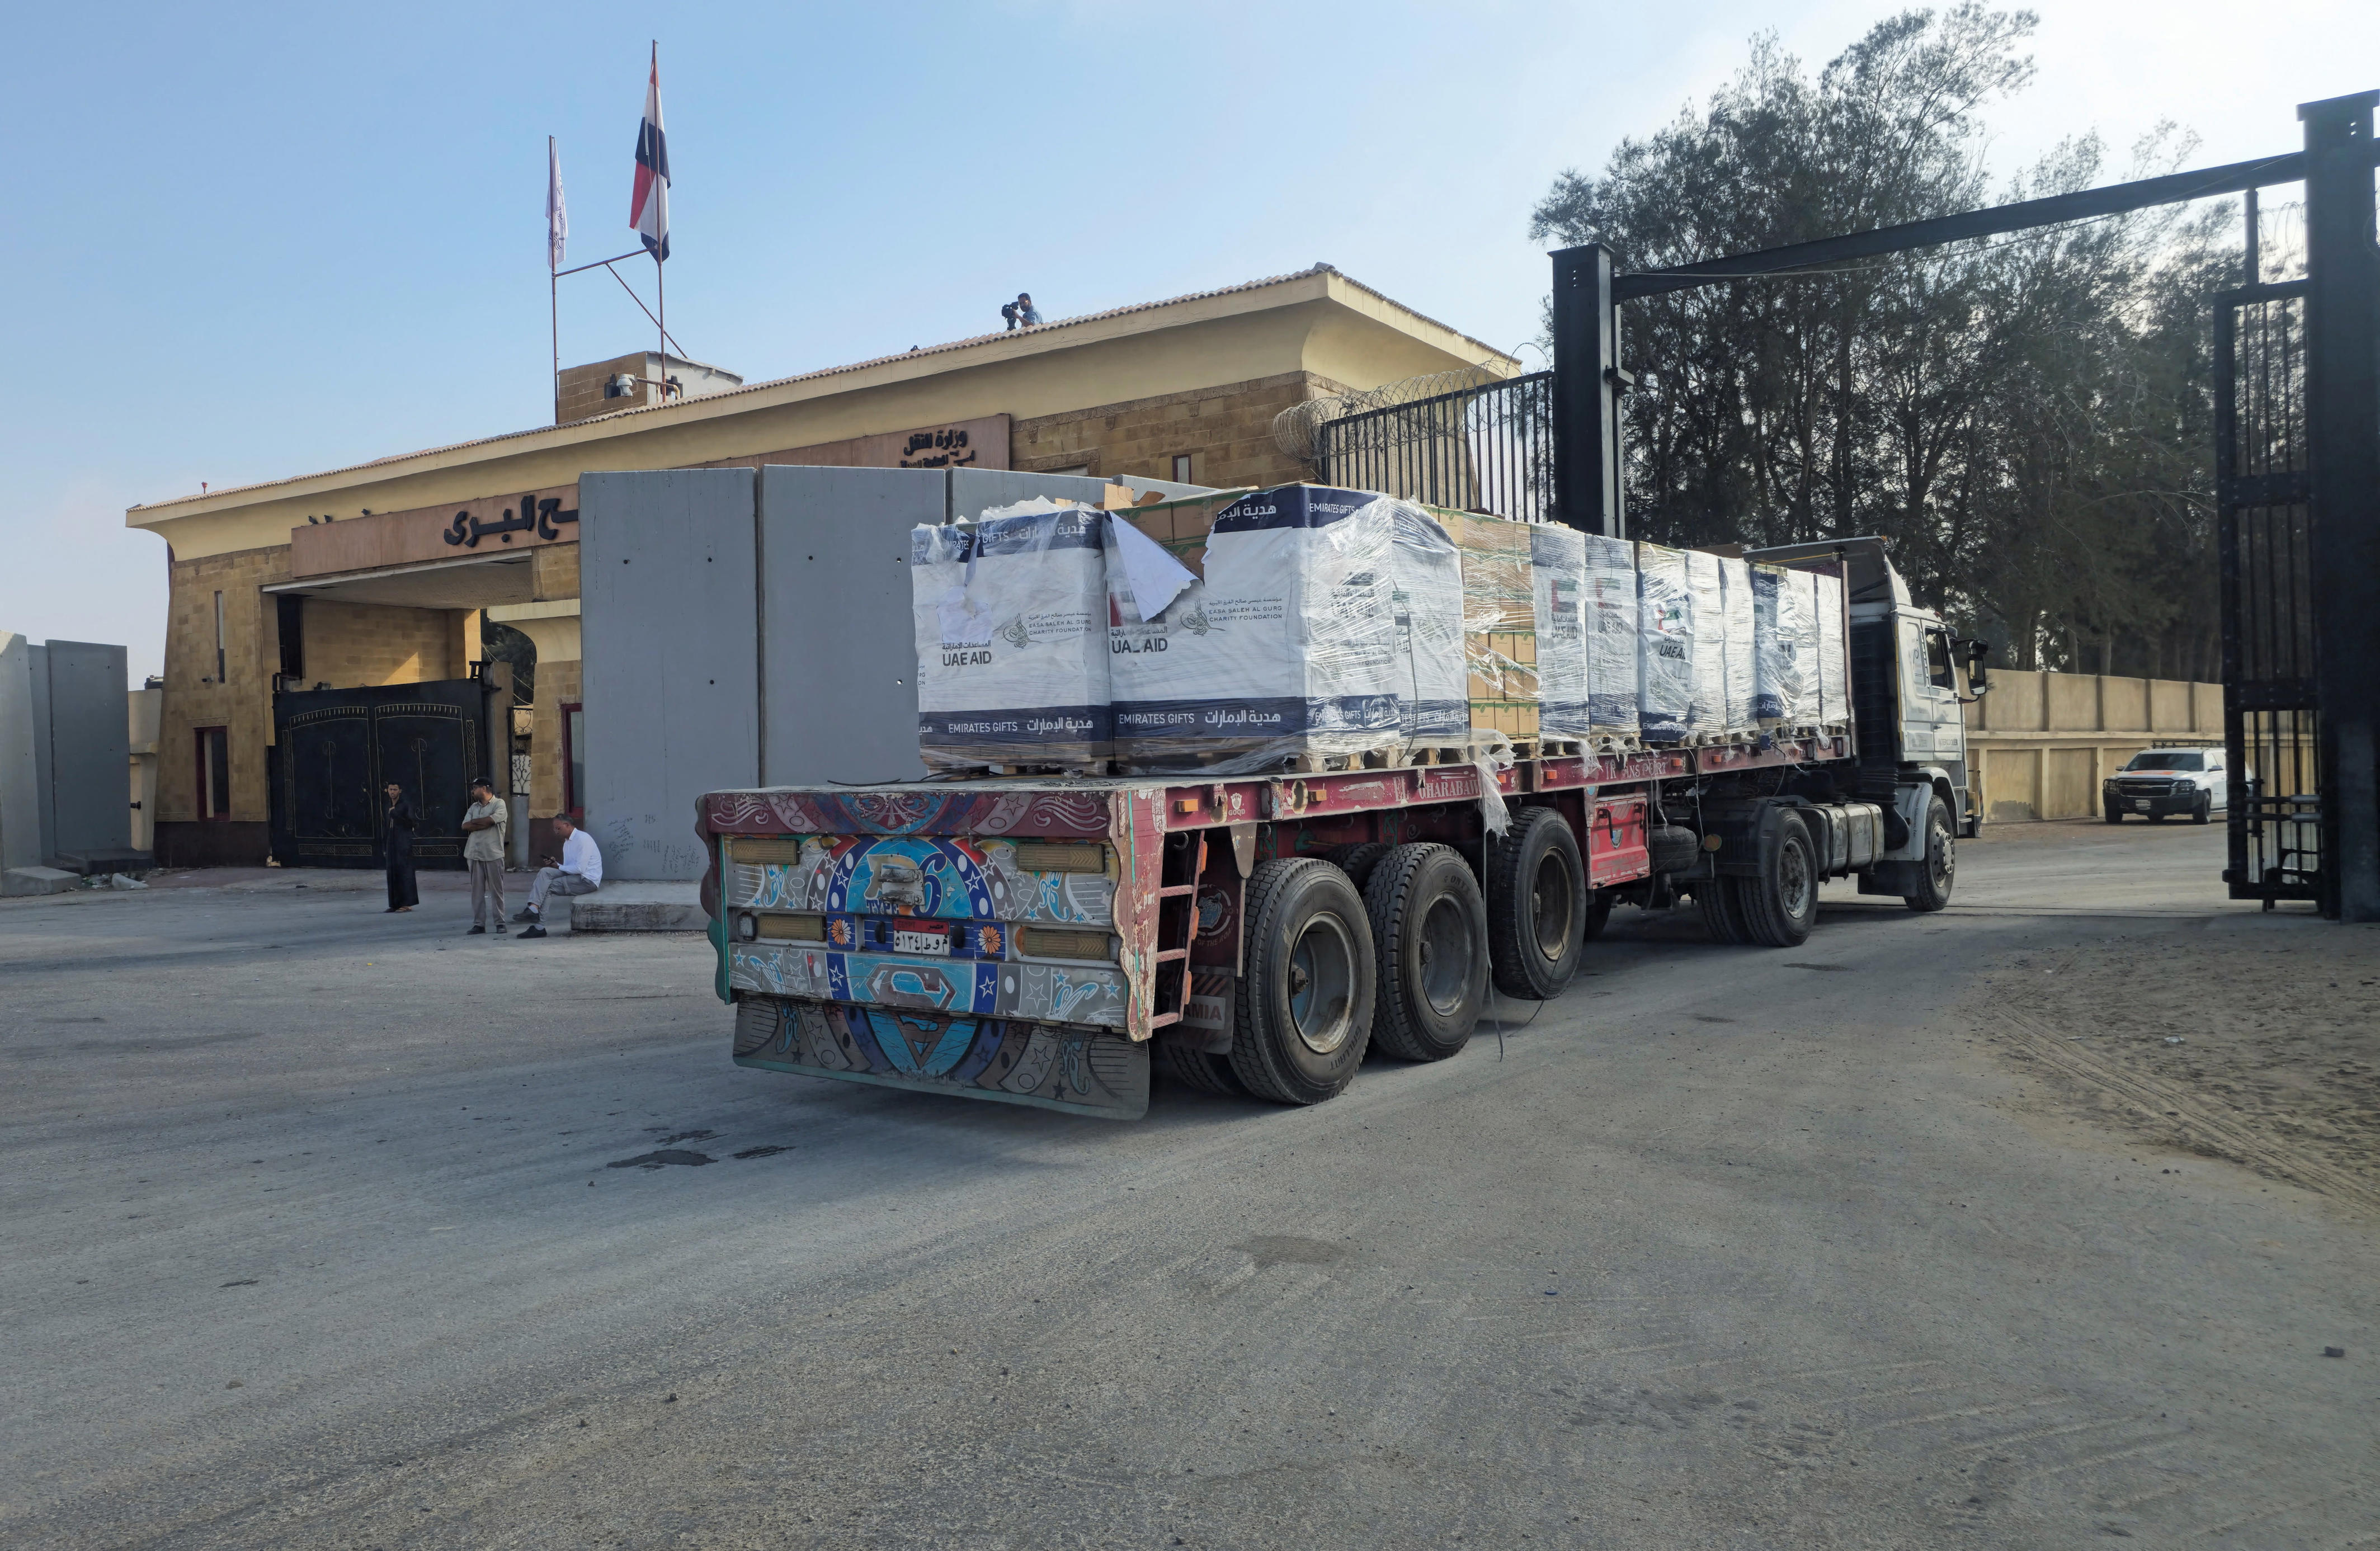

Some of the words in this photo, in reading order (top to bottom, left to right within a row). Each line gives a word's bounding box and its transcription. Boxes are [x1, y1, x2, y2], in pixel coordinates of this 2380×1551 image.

[1243, 503, 1276, 520] هدية
[1309, 502, 1339, 513] EMIRATES
[1339, 504, 1355, 515] GIFTS
[982, 531, 1009, 544] GIFTS
[1111, 640, 1140, 654] UA
[1143, 638, 1168, 653] AID
[1659, 644, 1677, 658] UAE
[942, 652, 968, 666] UAE
[970, 650, 992, 664] AID
[1119, 714, 1165, 724] EMIRATES
[1168, 713, 1195, 723] GIFTS
[1205, 709, 1246, 728] الإمارات
[1249, 709, 1280, 726] هدية
[1345, 710, 1361, 720] GIFTS
[948, 722, 991, 734] EMIRATES
[992, 722, 1018, 733] GIFTS
[1027, 716, 1064, 735] الإمارات
[1065, 716, 1094, 732] هدية
[866, 899, 900, 915] TYPE
[895, 934, 921, 951] ٥١٣٤
